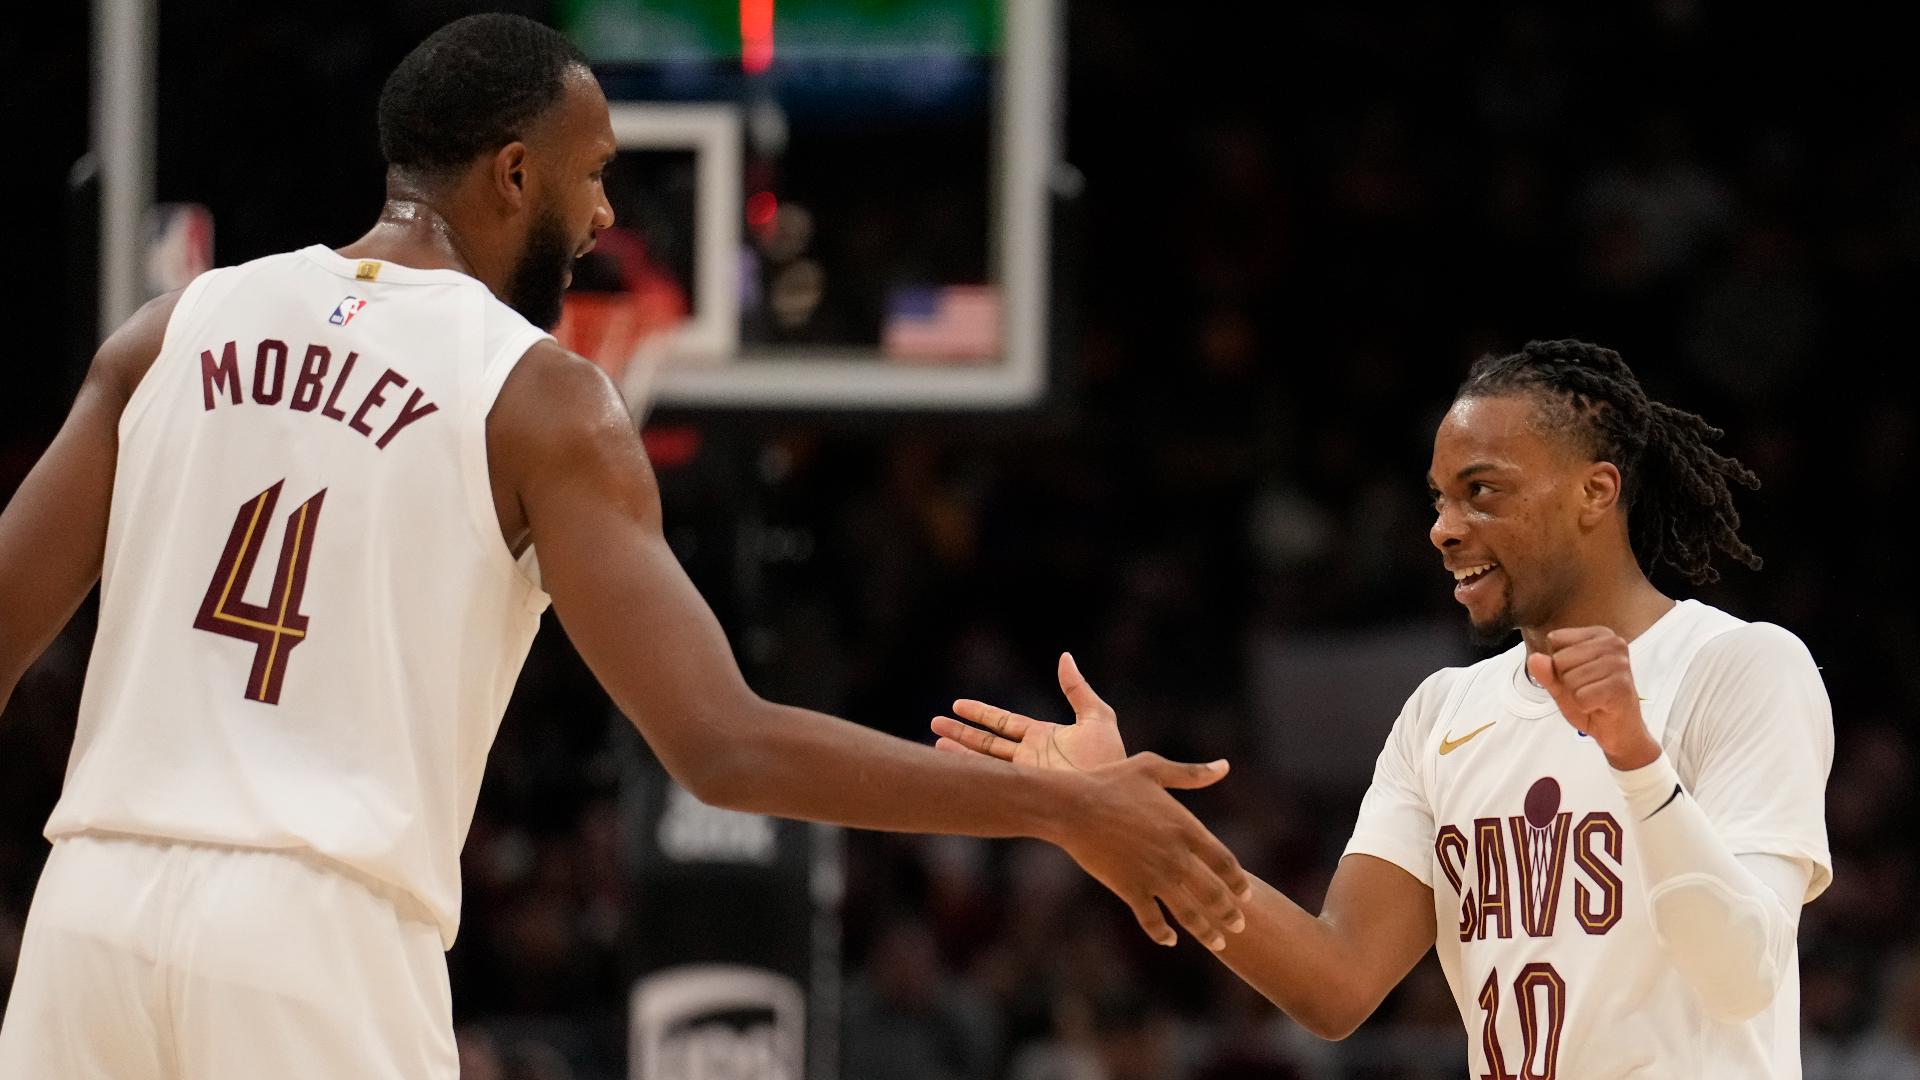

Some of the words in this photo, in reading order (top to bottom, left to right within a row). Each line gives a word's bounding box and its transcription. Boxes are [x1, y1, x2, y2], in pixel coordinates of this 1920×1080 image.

[201, 339, 439, 450] MOBLEY
[193, 477, 328, 705] 4
[1435, 811, 1623, 942] CAVS
[1478, 962, 1566, 1080] 10
